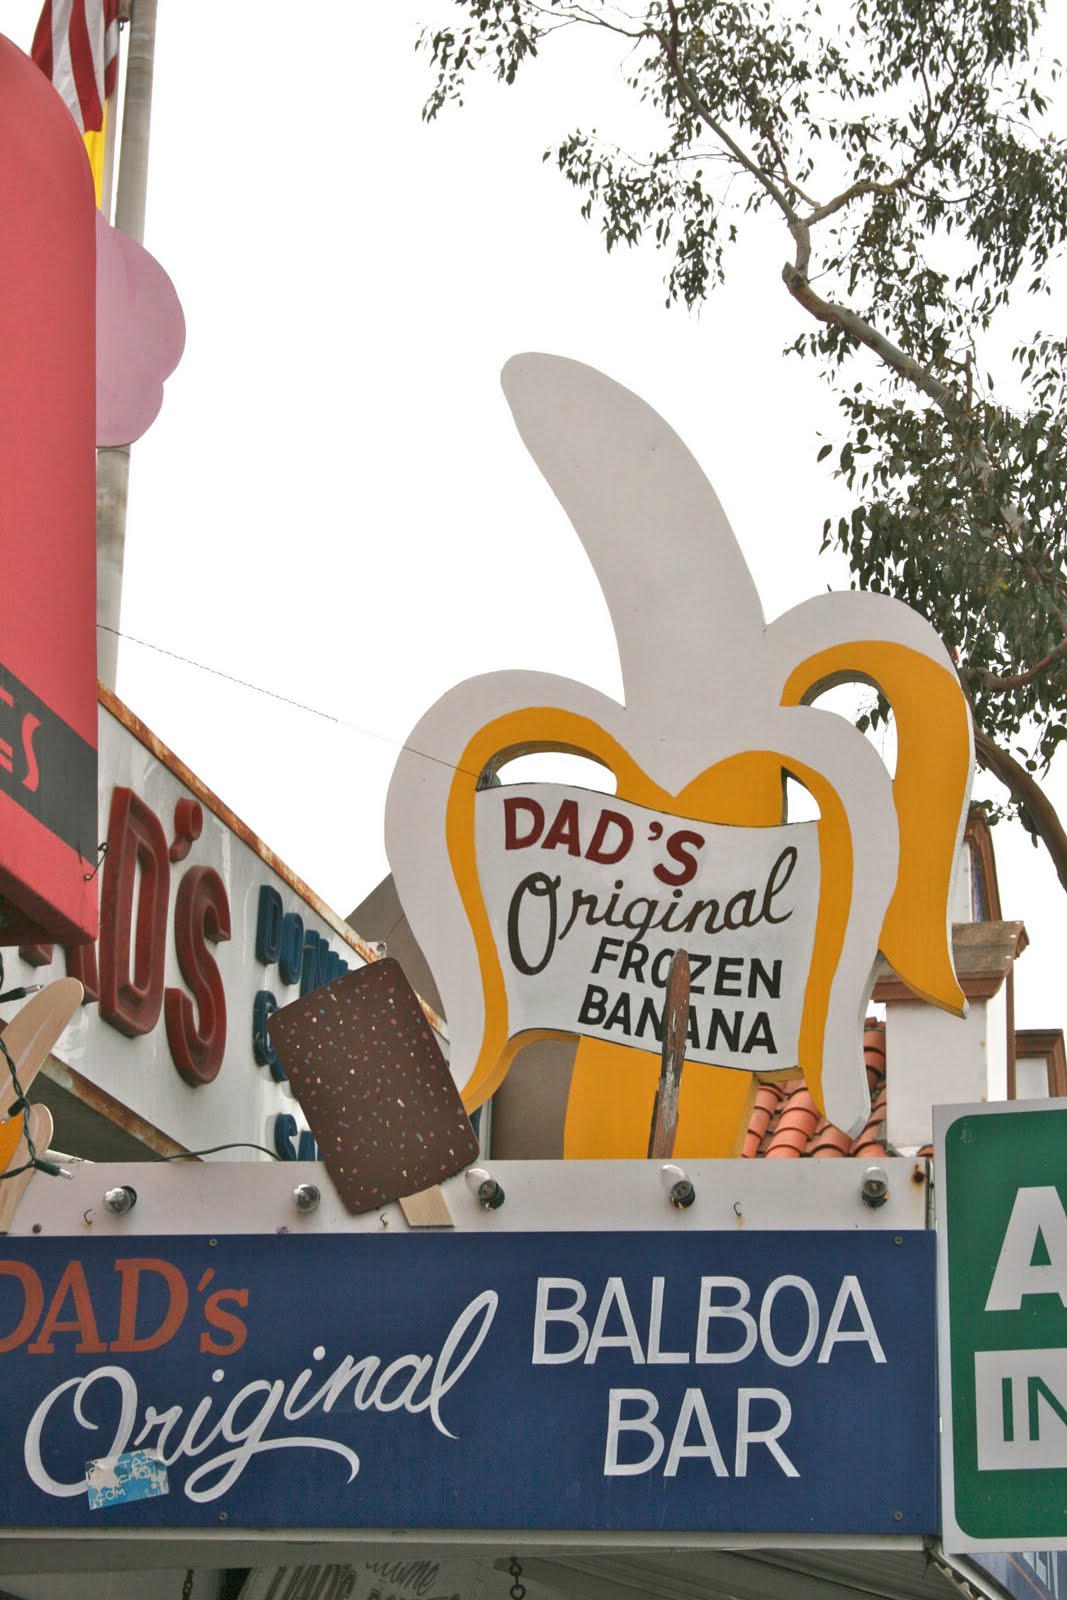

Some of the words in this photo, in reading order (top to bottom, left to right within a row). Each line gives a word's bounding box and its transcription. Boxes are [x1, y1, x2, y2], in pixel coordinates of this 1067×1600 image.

[503, 796, 706, 887] DAD'S
[507, 845, 797, 975] Original
[590, 936, 783, 999] FROZEN
[532, 1275, 887, 1367] BALBOA
[24, 1289, 499, 1503] Original
[603, 1388, 800, 1477] BAR
